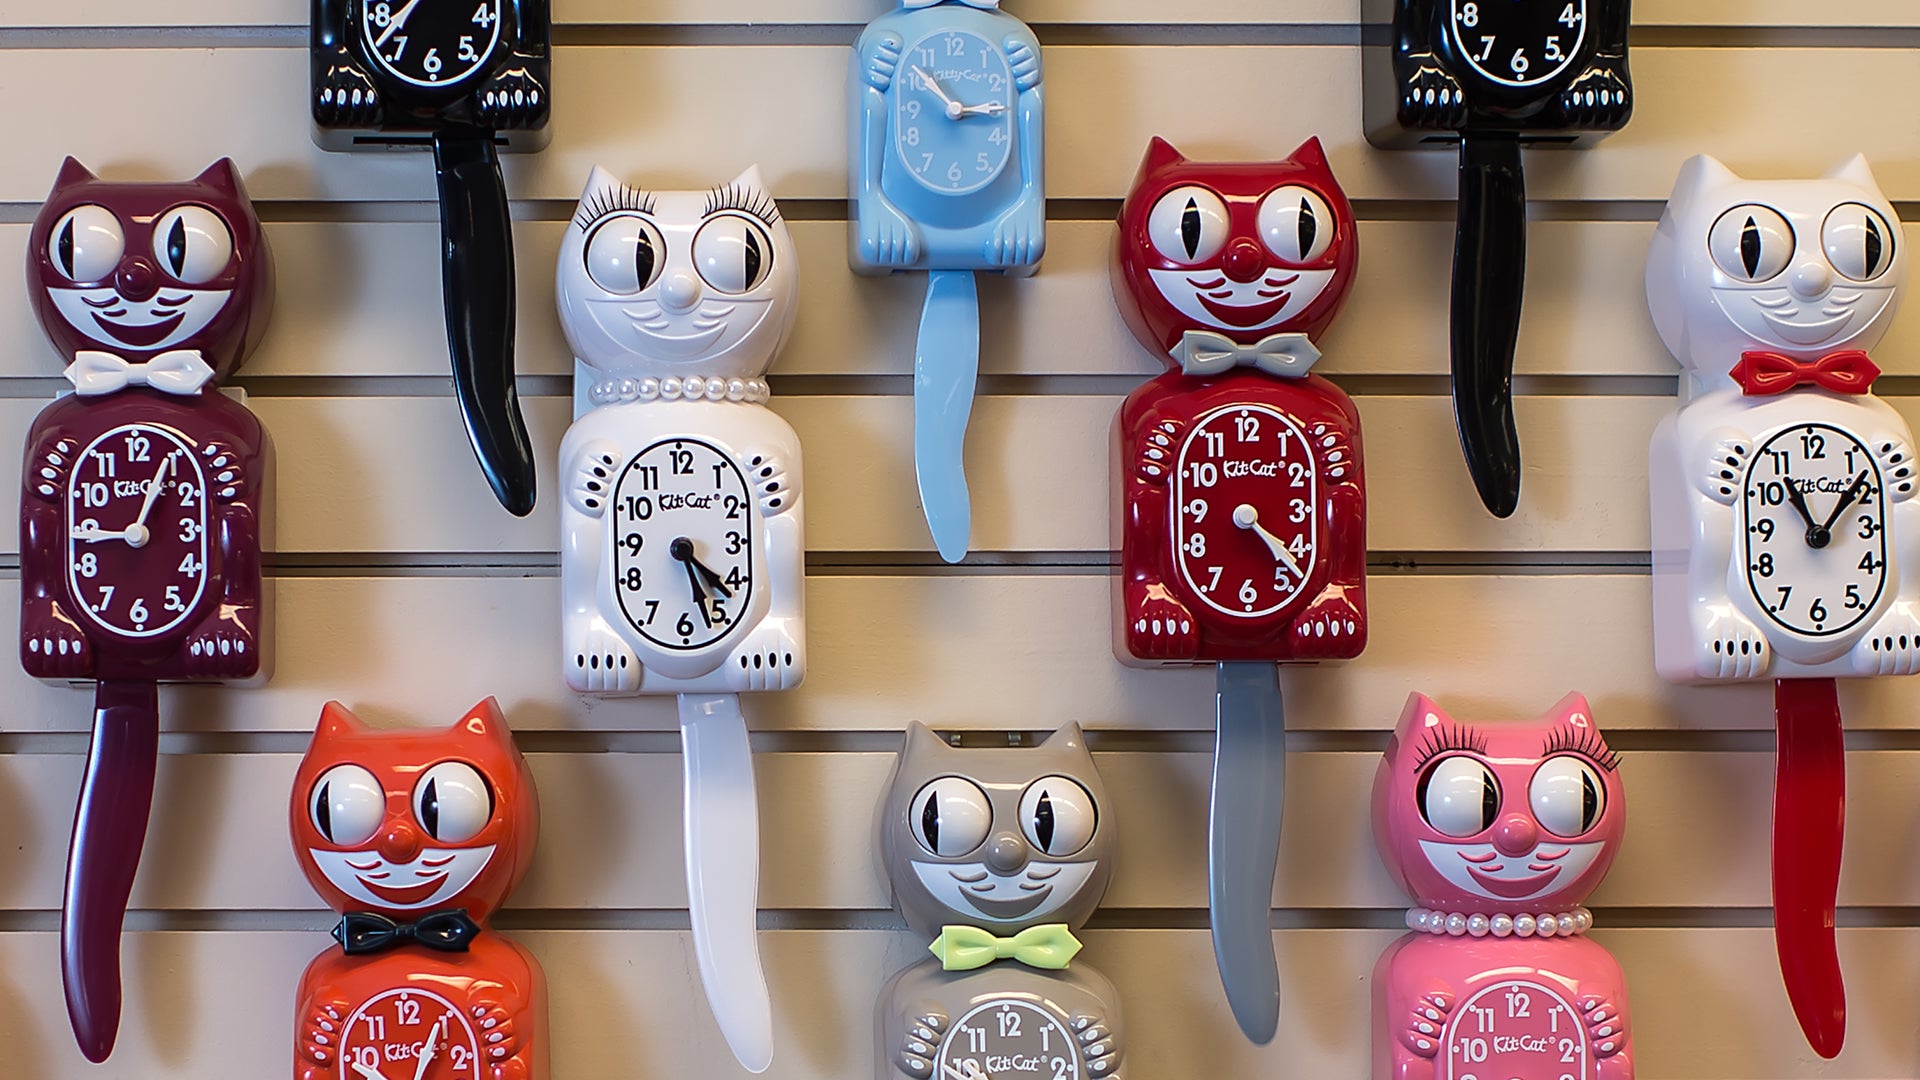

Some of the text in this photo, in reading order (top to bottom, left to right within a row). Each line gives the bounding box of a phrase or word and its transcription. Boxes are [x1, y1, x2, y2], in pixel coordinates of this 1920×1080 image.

[375, 3, 390, 27] 8
[472, 3, 490, 27] 4
[1463, 3, 1478, 27] 8
[1558, 3, 1576, 27] 4
[393, 36, 408, 60] 7
[458, 36, 474, 60] 5
[920, 49, 935, 67] 11
[945, 38, 964, 56] 12
[980, 50, 987, 68] 1
[1480, 36, 1496, 60] 7
[1544, 36, 1560, 60] 5
[423, 48, 442, 73] 6
[1510, 48, 1529, 73] 6
[989, 74, 1001, 92] 2
[907, 101, 921, 119] 9
[907, 127, 919, 146] 8
[988, 128, 1001, 146] 4
[922, 153, 934, 171] 7
[947, 162, 962, 181] 6
[976, 153, 989, 171] 5
[1235, 417, 1260, 442] 12
[125, 437, 150, 462] 12
[1205, 432, 1224, 457] 11
[1278, 432, 1287, 457] 1
[1800, 435, 1826, 459] 12
[96, 452, 115, 477] 11
[167, 452, 178, 477] 1
[669, 450, 694, 474] 12
[1771, 451, 1789, 475] 11
[1844, 451, 1853, 474] 1
[640, 466, 658, 490] 11
[712, 465, 722, 489] 1
[1190, 462, 1218, 487] 10
[1288, 463, 1304, 487] 2
[81, 482, 109, 508] 10
[178, 482, 195, 507] 2
[1757, 482, 1784, 506] 10
[1857, 481, 1872, 504] 2
[626, 496, 653, 521] 10
[724, 495, 739, 519] 2
[1190, 499, 1208, 523] 9
[1289, 499, 1305, 523] 3
[179, 518, 196, 542] 3
[1757, 518, 1775, 542] 9
[1858, 515, 1874, 539] 3
[625, 533, 643, 557] 9
[725, 531, 741, 555] 3
[1190, 533, 1206, 557] 8
[1288, 534, 1305, 558] 4
[81, 553, 97, 577] 8
[178, 553, 196, 577] 4
[1758, 553, 1774, 577] 8
[1858, 551, 1875, 575] 4
[627, 567, 642, 591] 8
[725, 566, 742, 591] 4
[1208, 567, 1223, 591] 7
[1273, 567, 1290, 591] 5
[99, 586, 115, 611] 7
[164, 586, 180, 610] 5
[1239, 579, 1257, 603] 6
[1777, 586, 1792, 610] 7
[1844, 584, 1860, 608] 5
[129, 599, 148, 623] 6
[645, 600, 660, 625] 7
[711, 600, 726, 623] 5
[1809, 598, 1827, 622] 6
[676, 613, 694, 637] 6
[395, 1000, 420, 1025] 12
[1505, 993, 1530, 1017] 12
[366, 1016, 384, 1040] 11
[439, 1015, 448, 1039] 1
[996, 1012, 1021, 1037] 12
[1475, 1008, 1494, 1032] 11
[1548, 1008, 1558, 1032] 1
[967, 1028, 986, 1053] 11
[1040, 1027, 1049, 1051] 1
[1461, 1038, 1488, 1062] 10
[1558, 1038, 1575, 1063] 2
[352, 1046, 379, 1071] 10
[450, 1045, 467, 1070] 2
[1050, 1057, 1066, 1080] 2
